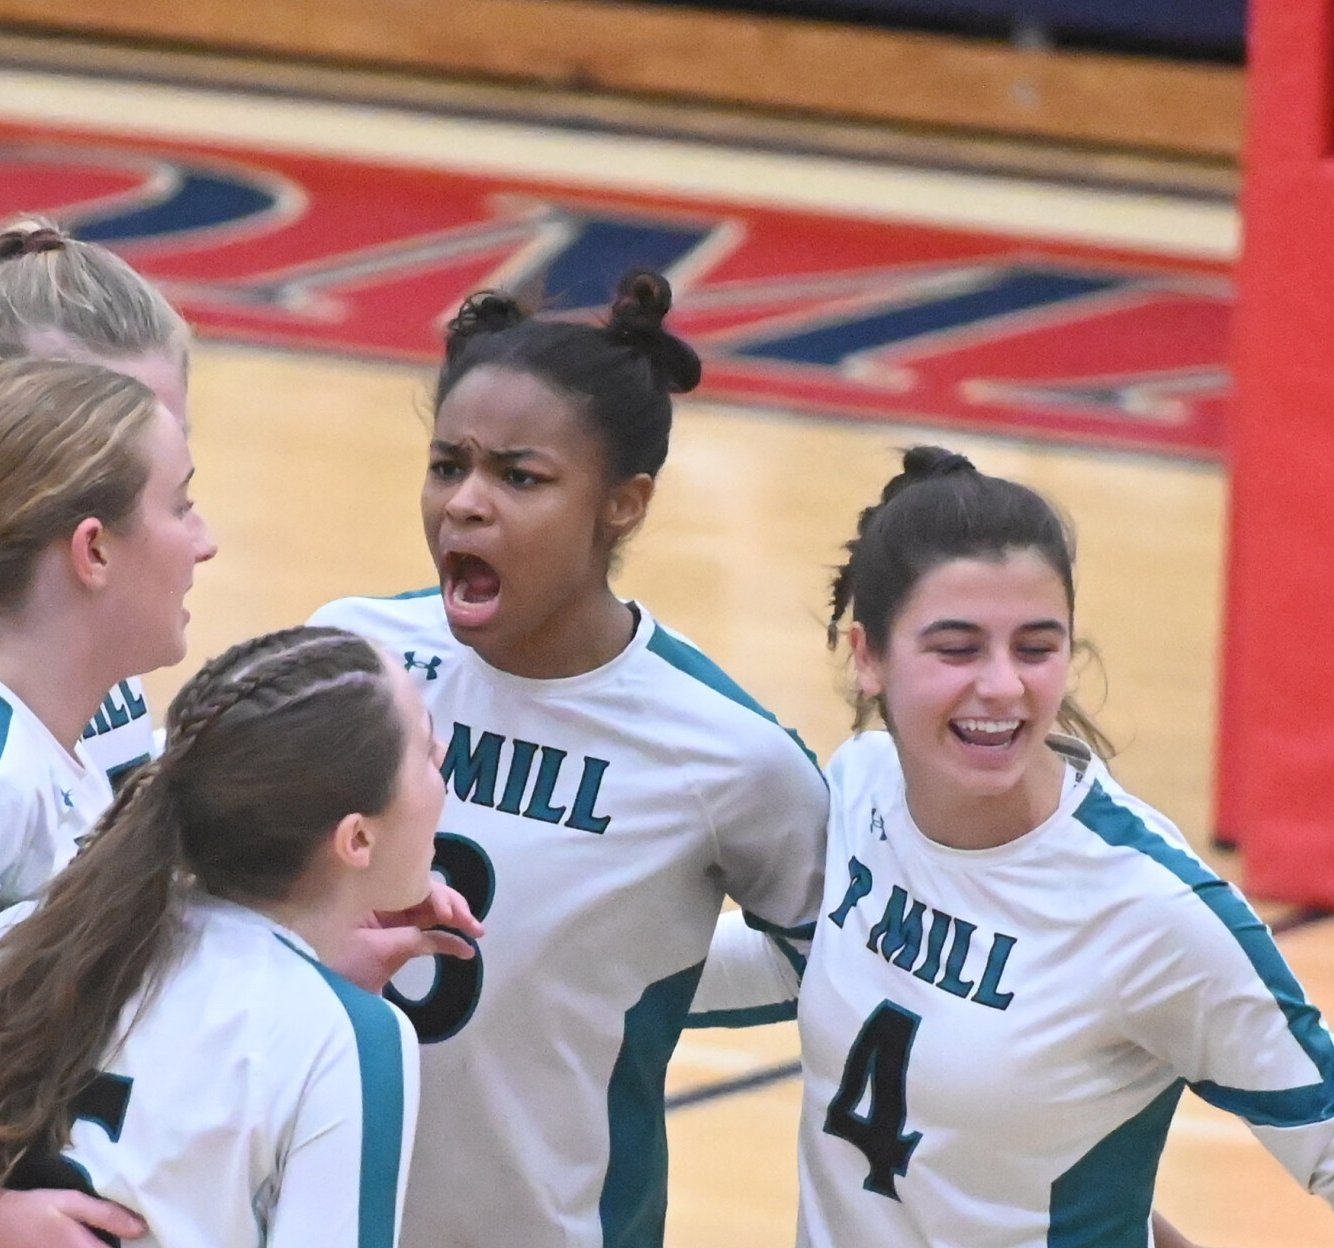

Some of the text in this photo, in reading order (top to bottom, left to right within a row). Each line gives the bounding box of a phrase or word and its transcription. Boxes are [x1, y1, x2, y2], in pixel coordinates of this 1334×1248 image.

[439, 721, 612, 835] MILL
[866, 884, 1018, 1011] MILL
[823, 998, 923, 1203] 4
